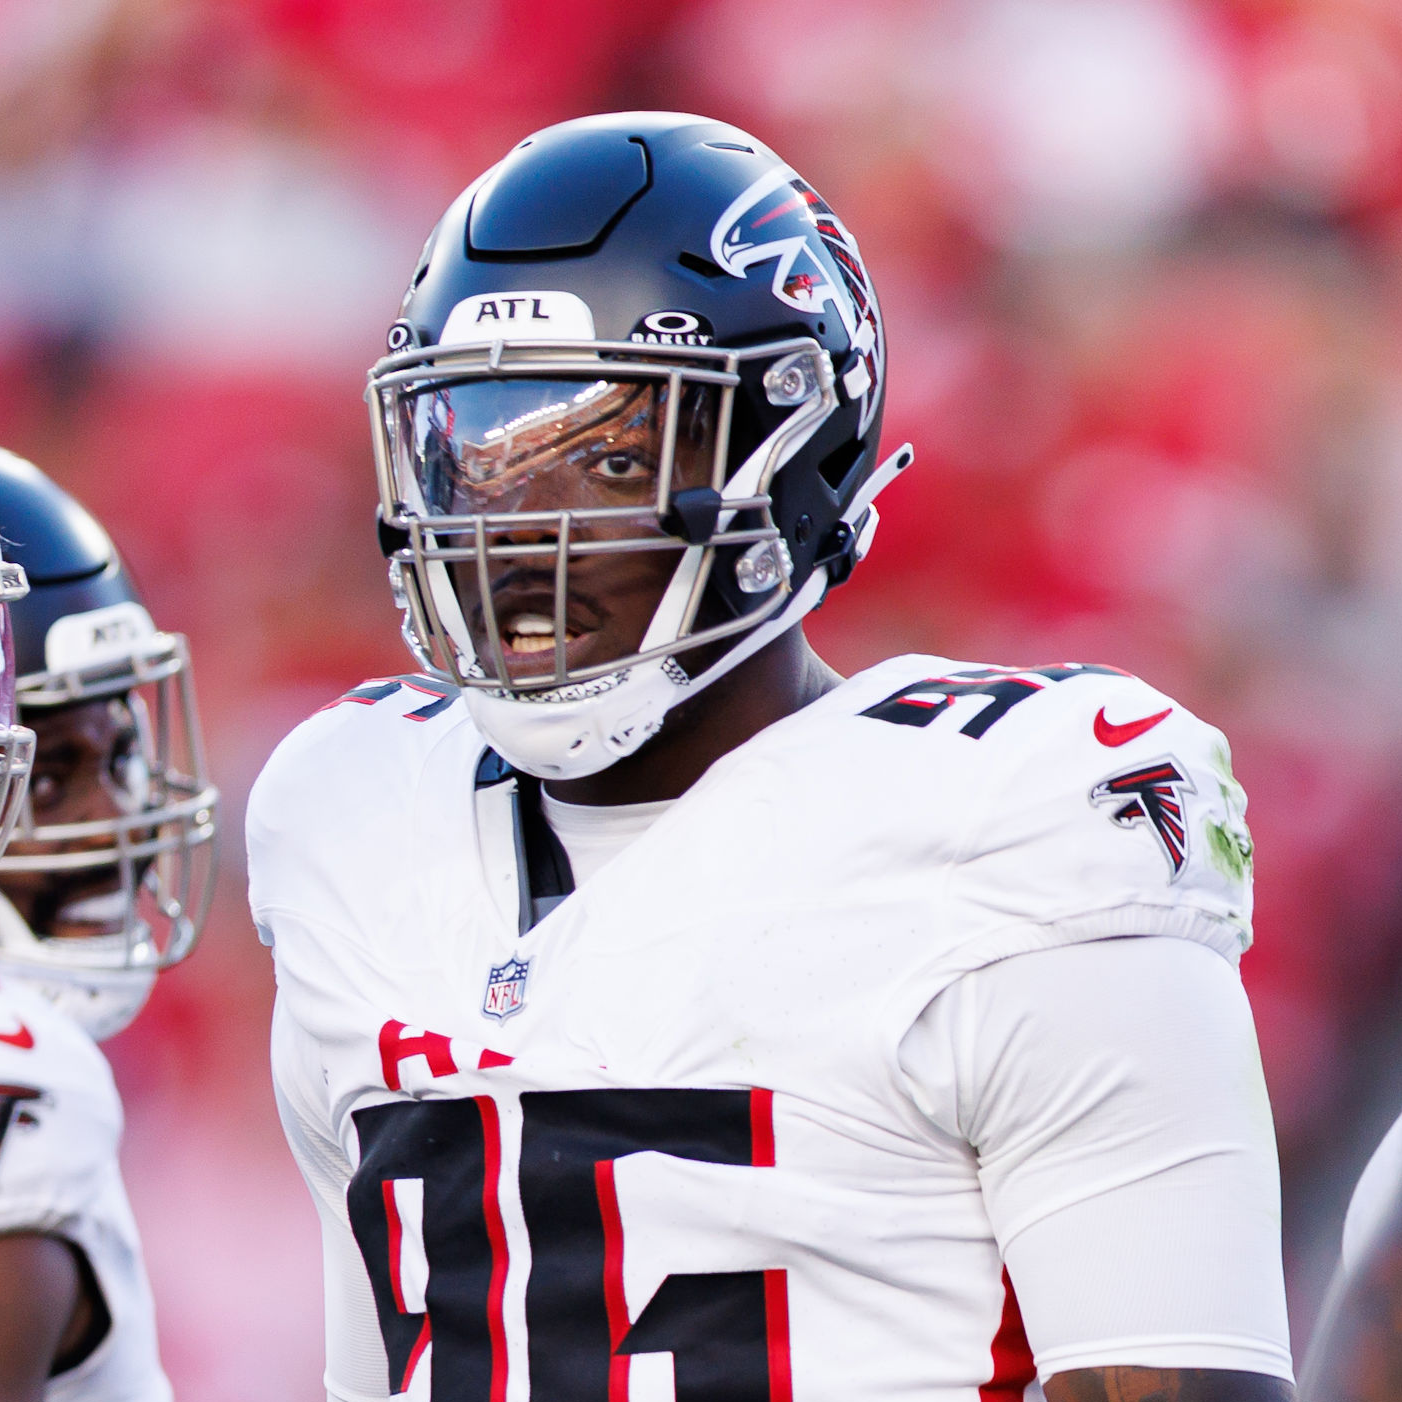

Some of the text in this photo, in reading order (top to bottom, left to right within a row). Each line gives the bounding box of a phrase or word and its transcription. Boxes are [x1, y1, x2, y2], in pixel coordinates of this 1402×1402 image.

[476, 298, 550, 323] ATL
[630, 331, 711, 346] OAKLEY
[487, 982, 519, 1011] NFL
